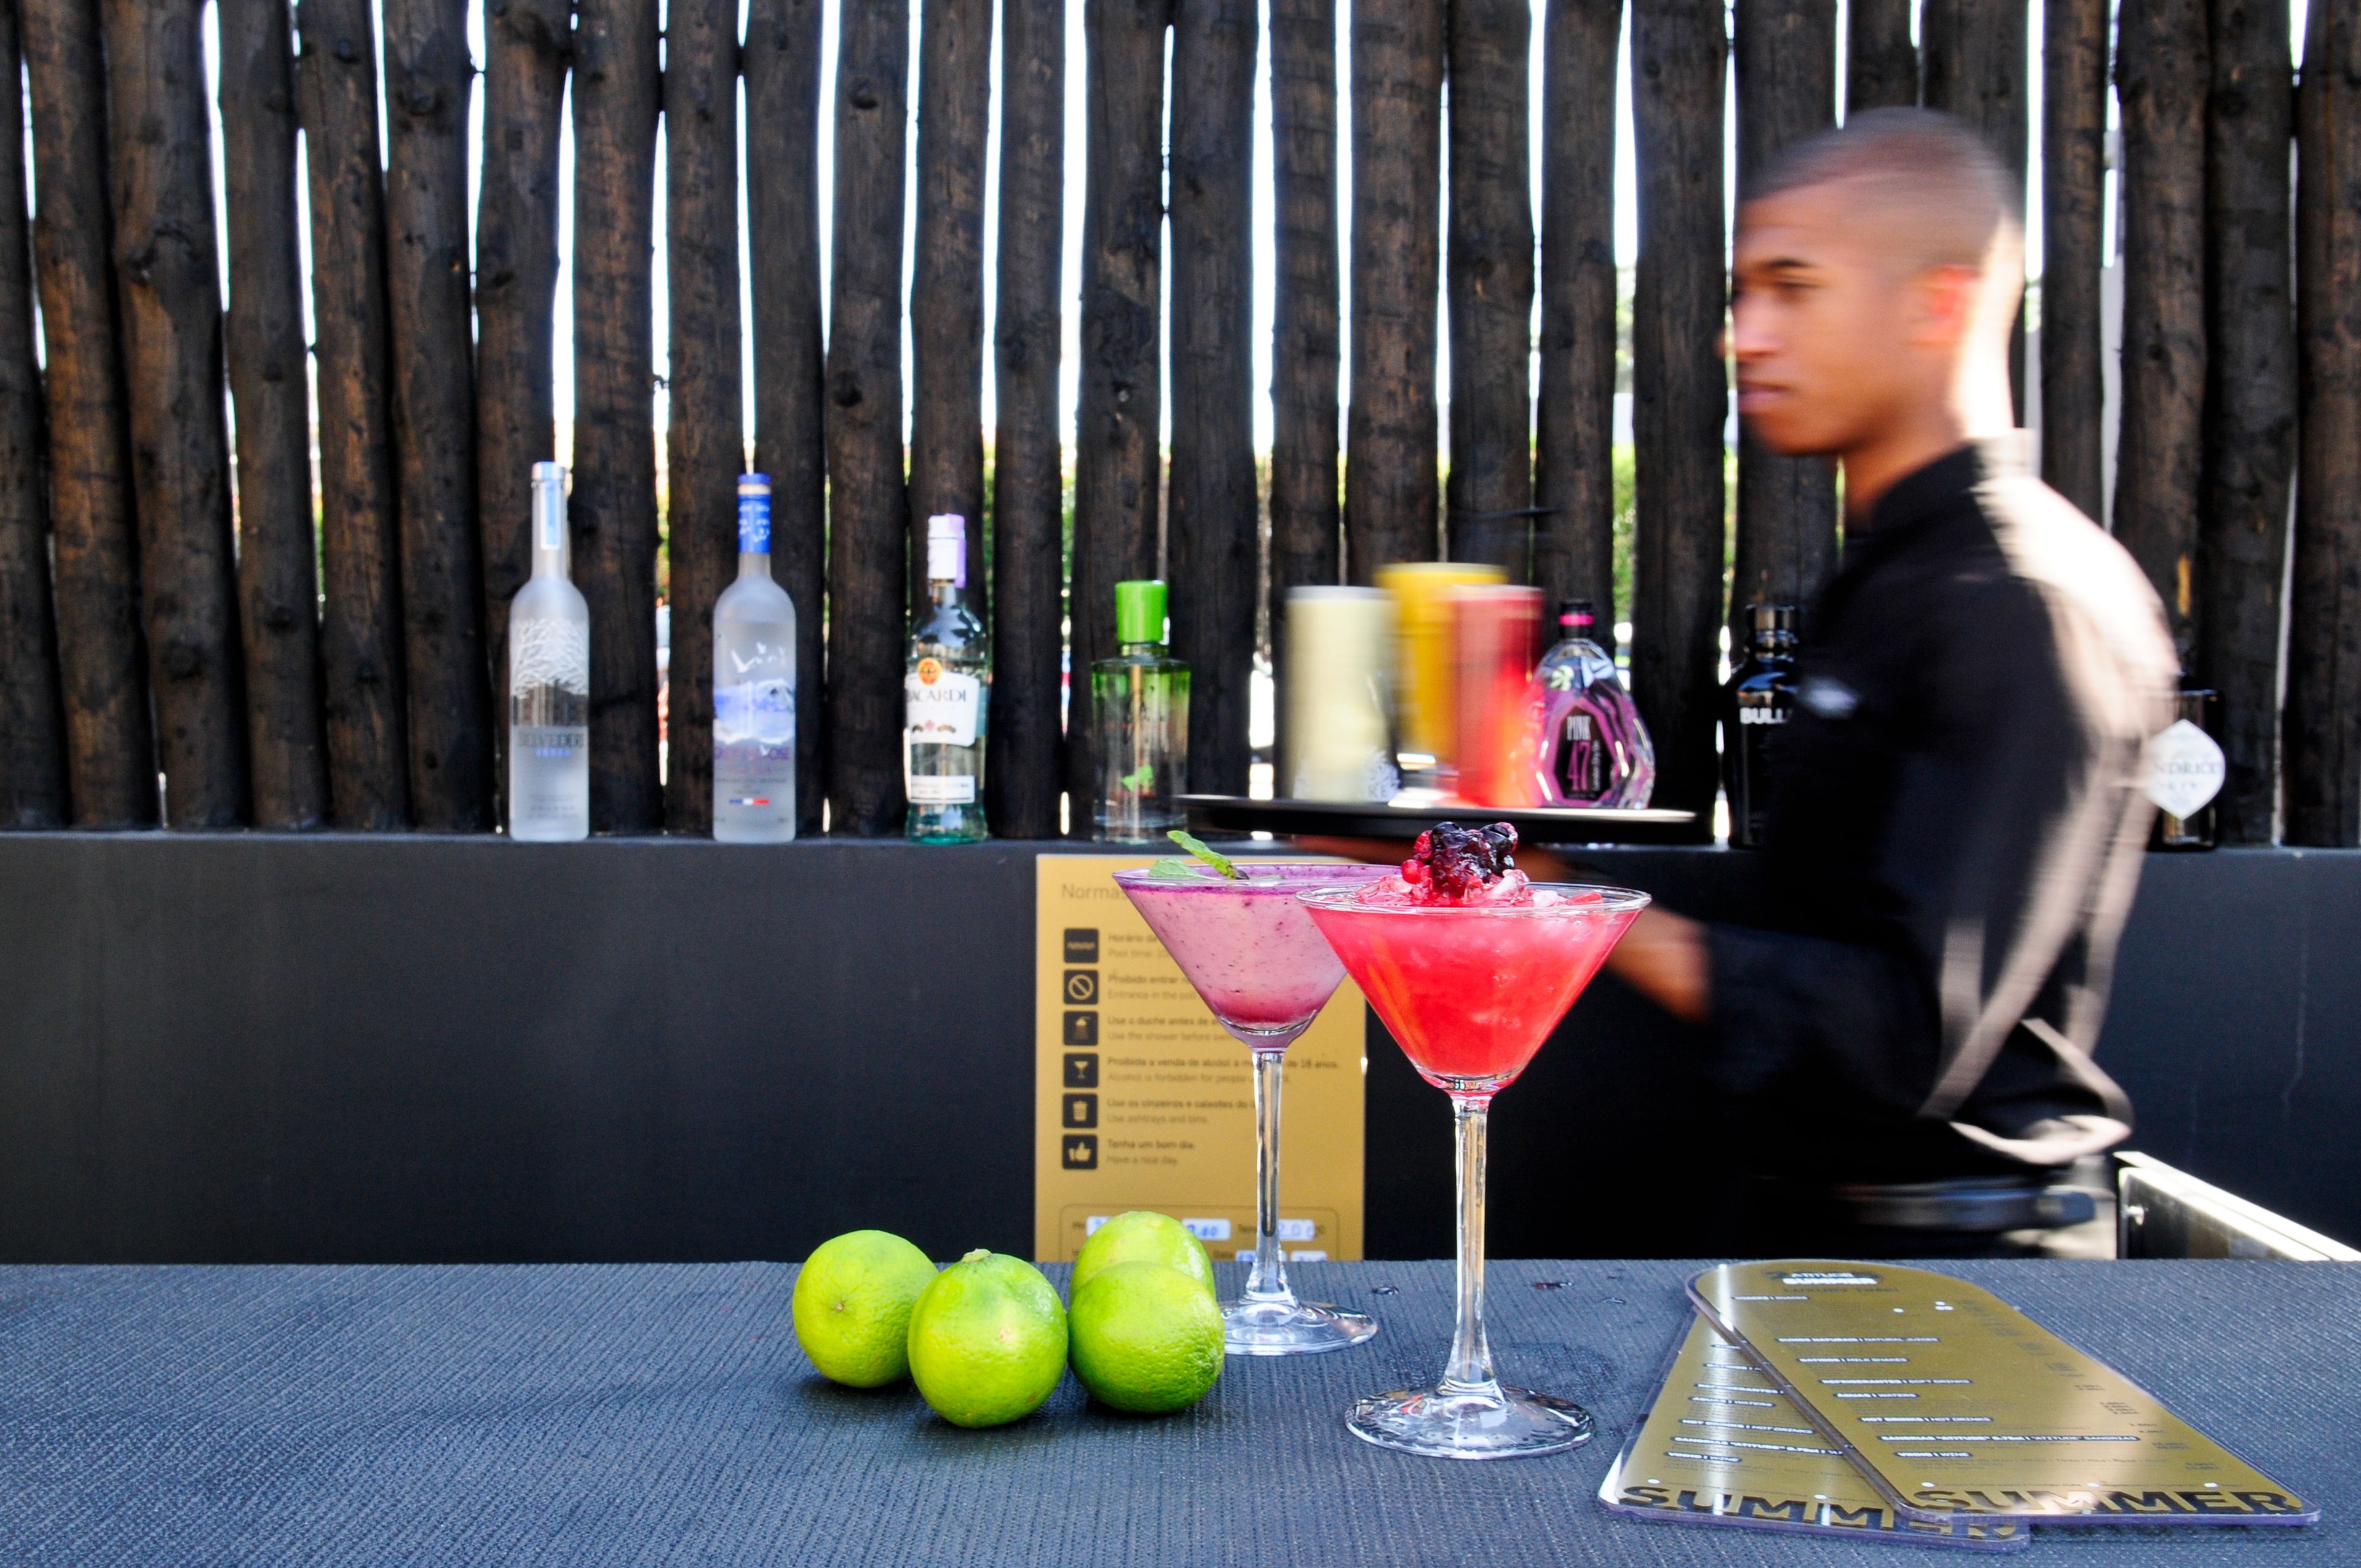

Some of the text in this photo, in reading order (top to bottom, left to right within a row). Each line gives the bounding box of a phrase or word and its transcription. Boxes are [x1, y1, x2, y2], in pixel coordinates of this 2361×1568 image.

[1739, 707, 1790, 724] BULL
[1567, 715, 1591, 741] PINK
[1567, 740, 1591, 791] 47
[1913, 1491, 2290, 1514] SUMMER
